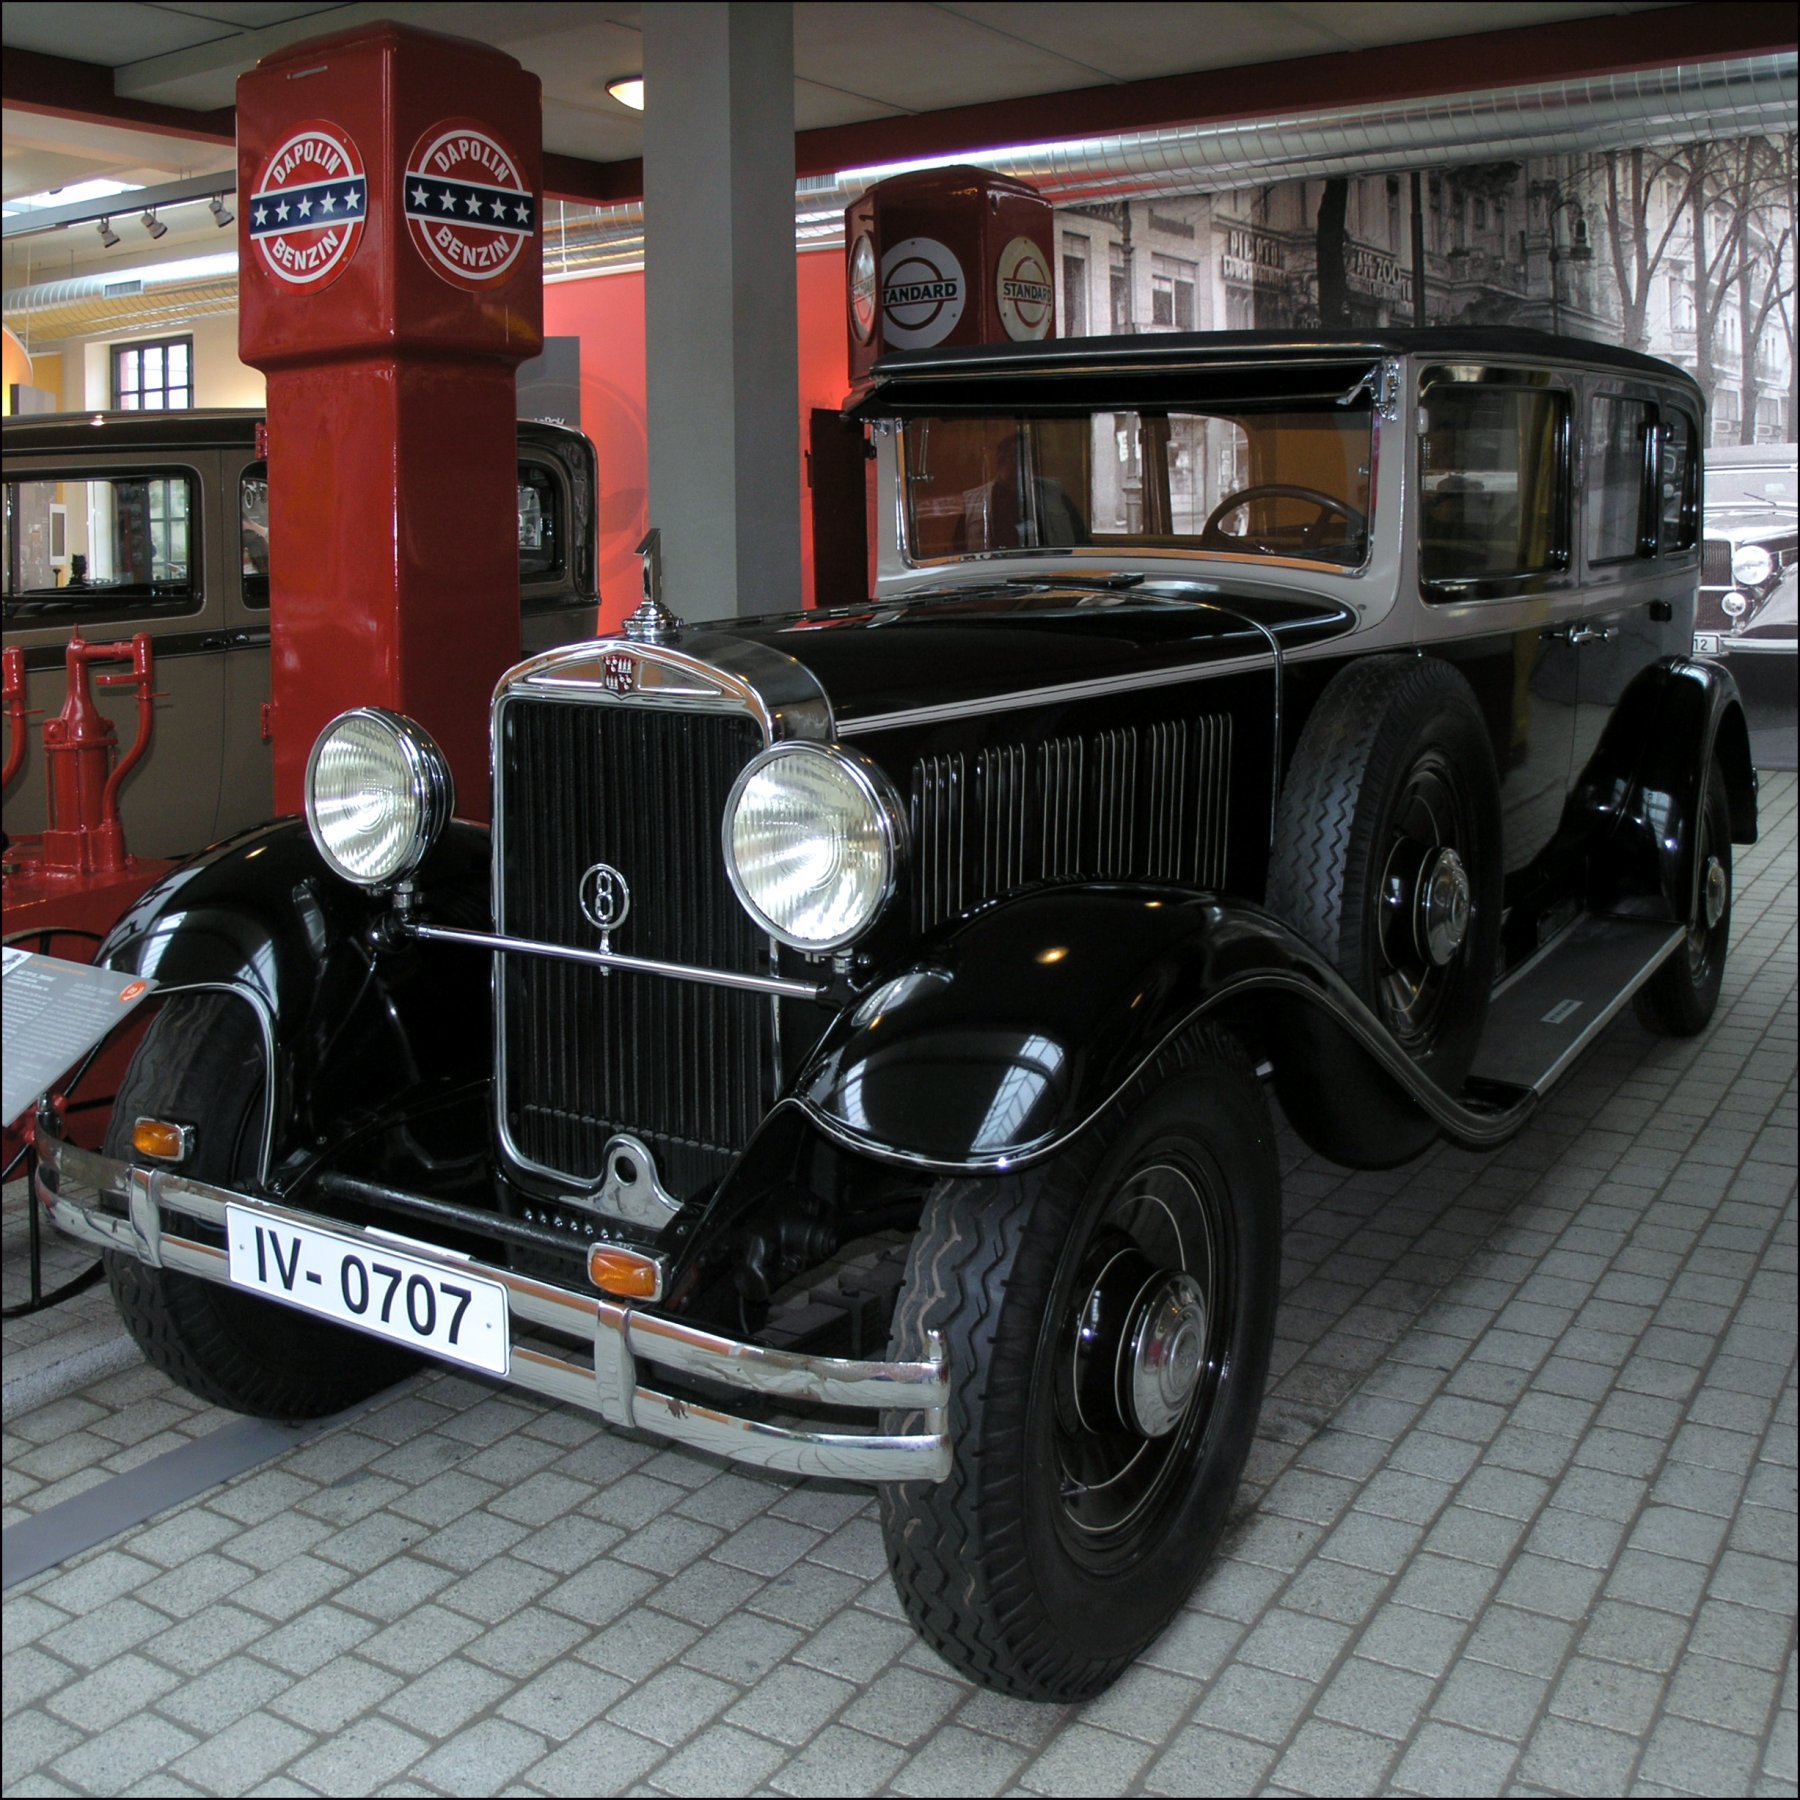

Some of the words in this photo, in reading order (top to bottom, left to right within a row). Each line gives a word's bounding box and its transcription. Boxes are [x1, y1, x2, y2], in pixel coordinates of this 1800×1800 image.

[272, 140, 342, 184] DAPOLIN
[434, 139, 511, 183] DAPOLIN
[272, 229, 339, 271] BENZIN
[435, 225, 511, 267] BENZIN
[1376, 257, 1401, 284] ZOO
[882, 282, 957, 304] TANDARD
[1003, 282, 1051, 302] STANDARD
[595, 871, 613, 921] 8
